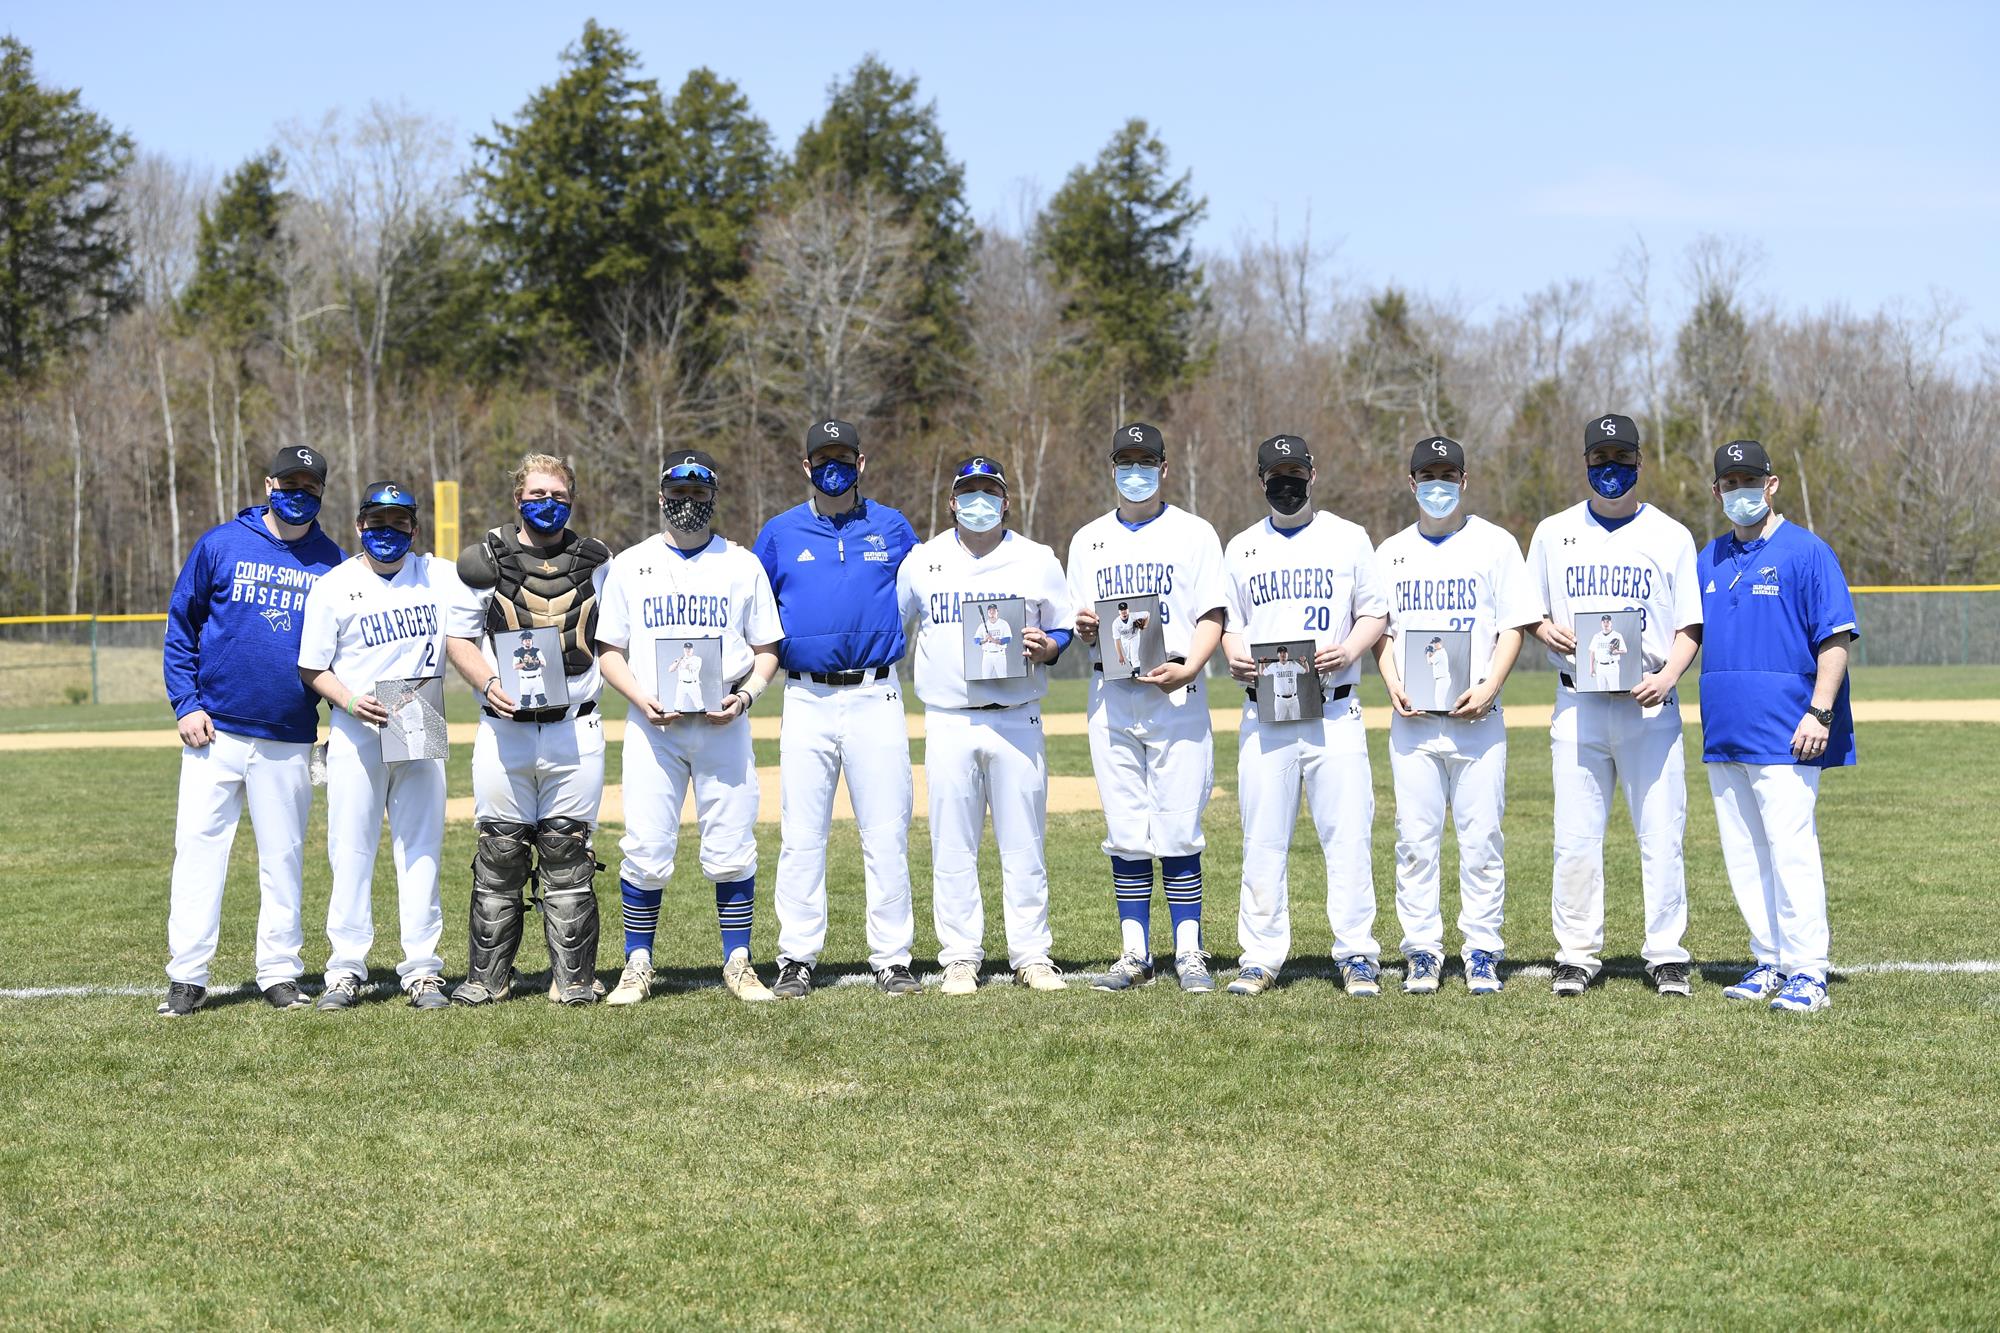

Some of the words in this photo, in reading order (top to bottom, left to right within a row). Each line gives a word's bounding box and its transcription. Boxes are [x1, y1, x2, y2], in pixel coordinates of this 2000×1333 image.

[235, 561, 319, 589] COLBY-SAWY
[1096, 563, 1173, 599] CHARGERS
[1250, 568, 1333, 606] CHARGERS
[1566, 565, 1652, 600] CHARGERS
[231, 583, 304, 611] BASEBA
[643, 594, 728, 628] CHARGERS
[1396, 578, 1476, 612] CHARGERS
[360, 604, 437, 647] CHARGERS
[1304, 606, 1329, 631] 20
[425, 643, 435, 666] 2
